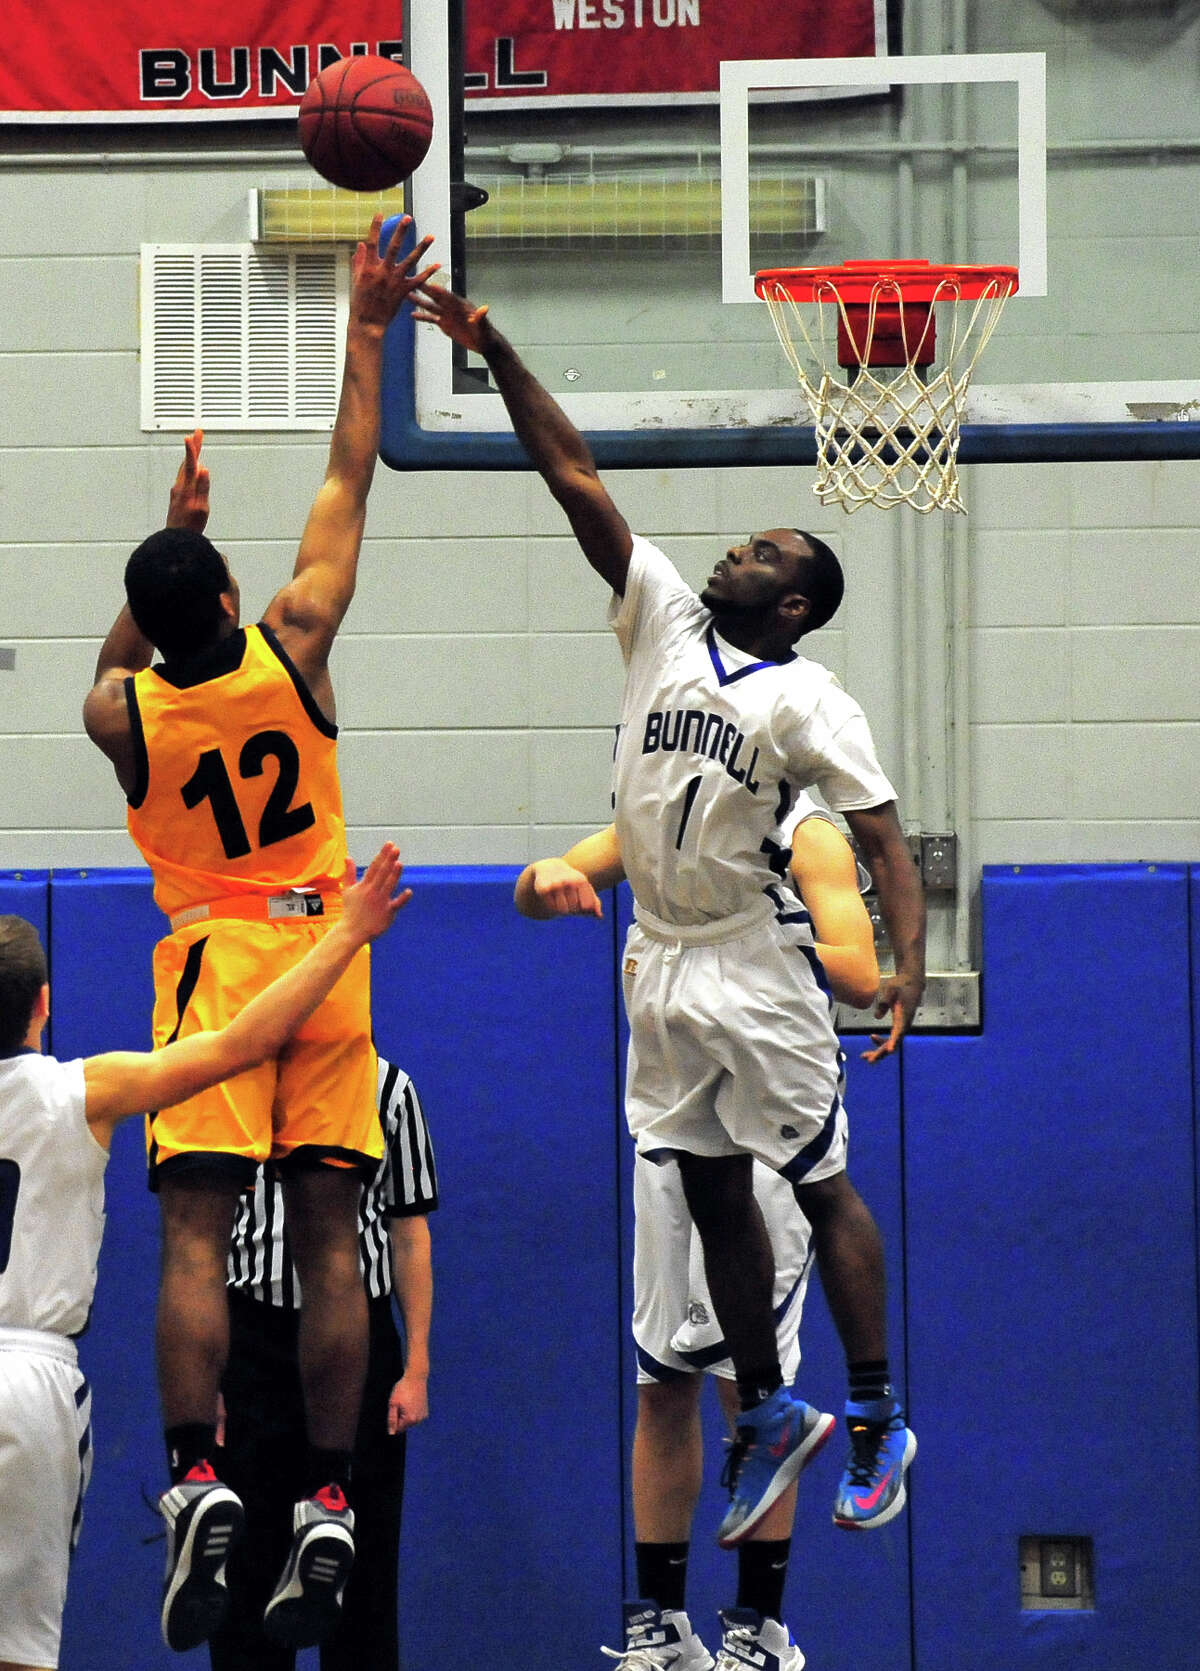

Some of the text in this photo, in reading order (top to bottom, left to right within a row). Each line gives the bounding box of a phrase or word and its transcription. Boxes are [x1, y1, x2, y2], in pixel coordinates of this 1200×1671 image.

[140, 38, 547, 100] BUNL
[643, 710, 759, 794] BUNNELL
[181, 730, 315, 859] 12
[676, 775, 703, 850] 1
